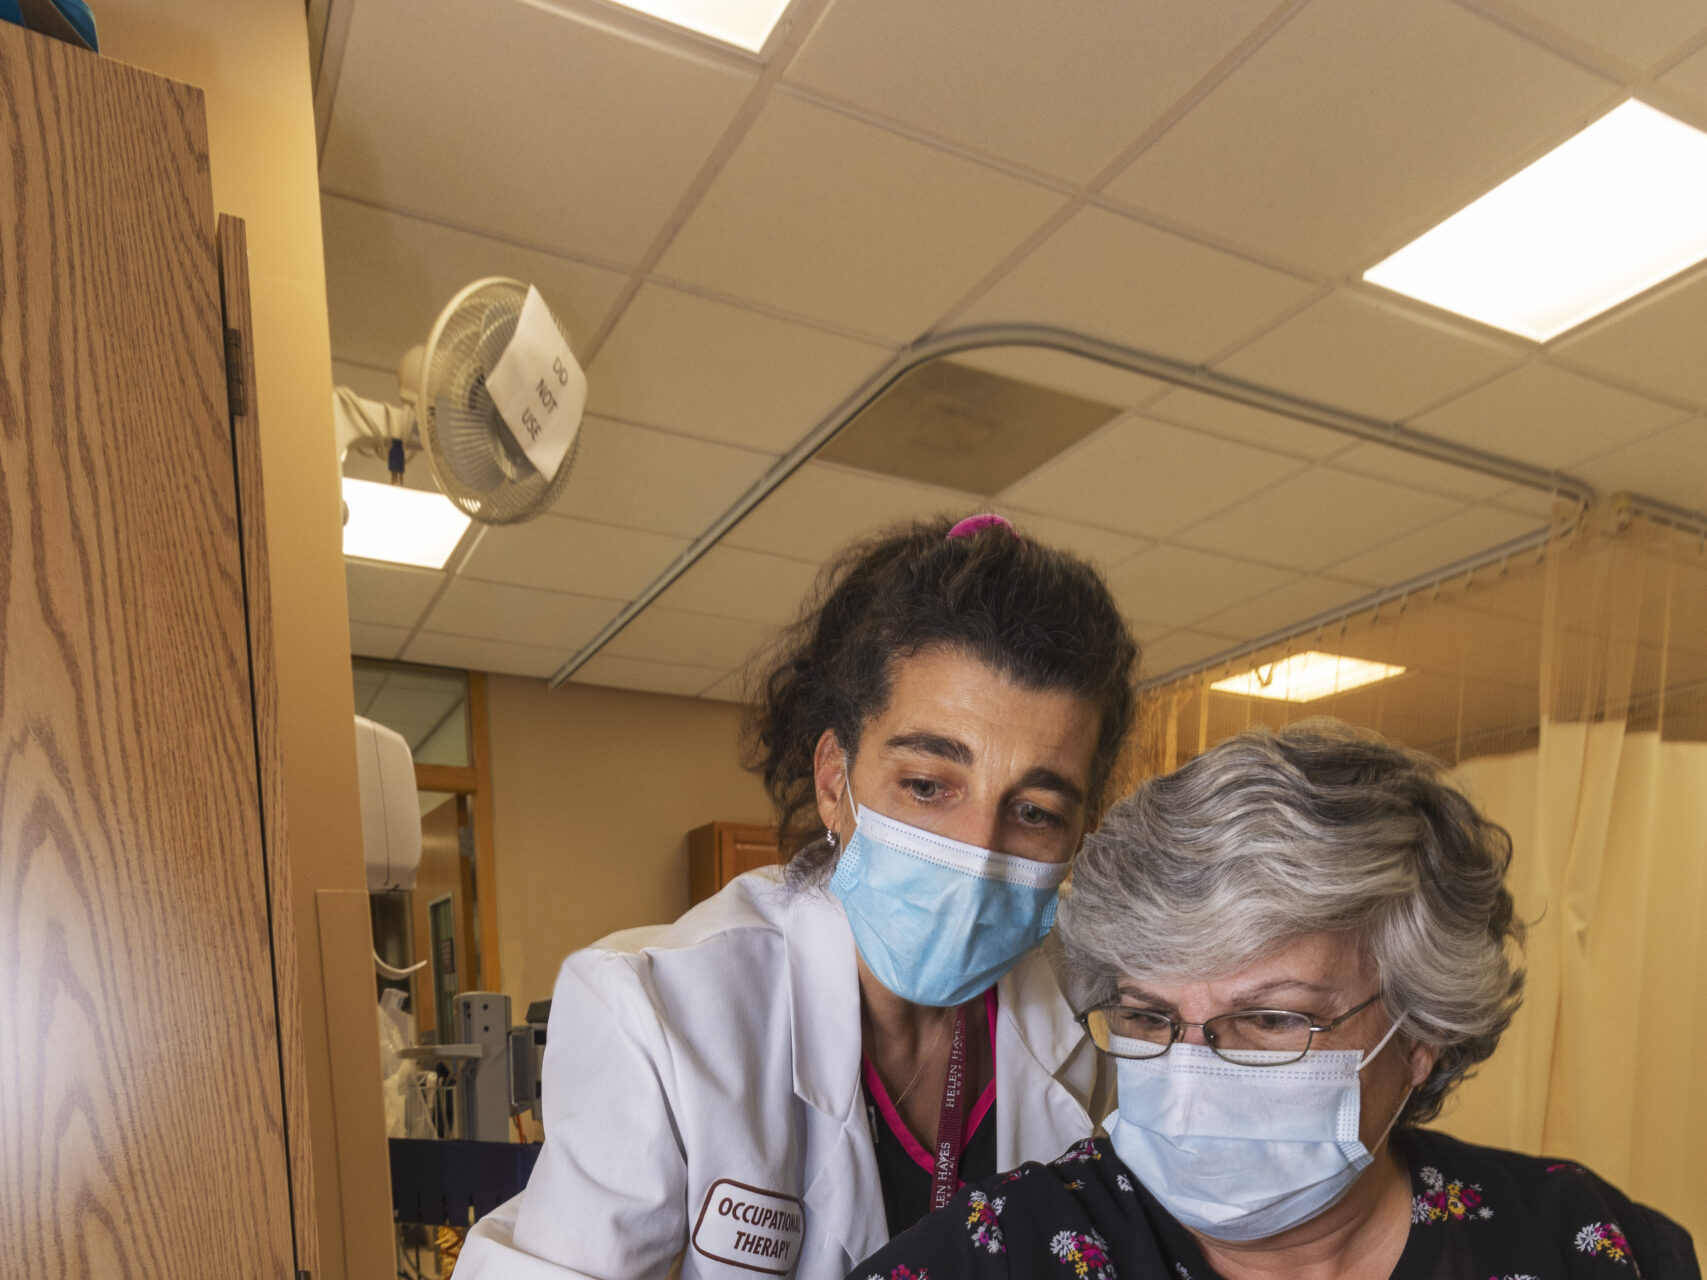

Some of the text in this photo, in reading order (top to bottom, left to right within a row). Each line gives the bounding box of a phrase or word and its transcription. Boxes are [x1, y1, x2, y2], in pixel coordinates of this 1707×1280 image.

[553, 357, 569, 386] DO
[536, 377, 558, 414] NOT
[522, 407, 542, 441] USE
[946, 1020, 961, 1108] HELEN HAYES
[936, 1142, 951, 1209] LEN HAYES
[718, 1197, 800, 1233] OCCUPATIONAL
[733, 1230, 792, 1260] THERAPY
